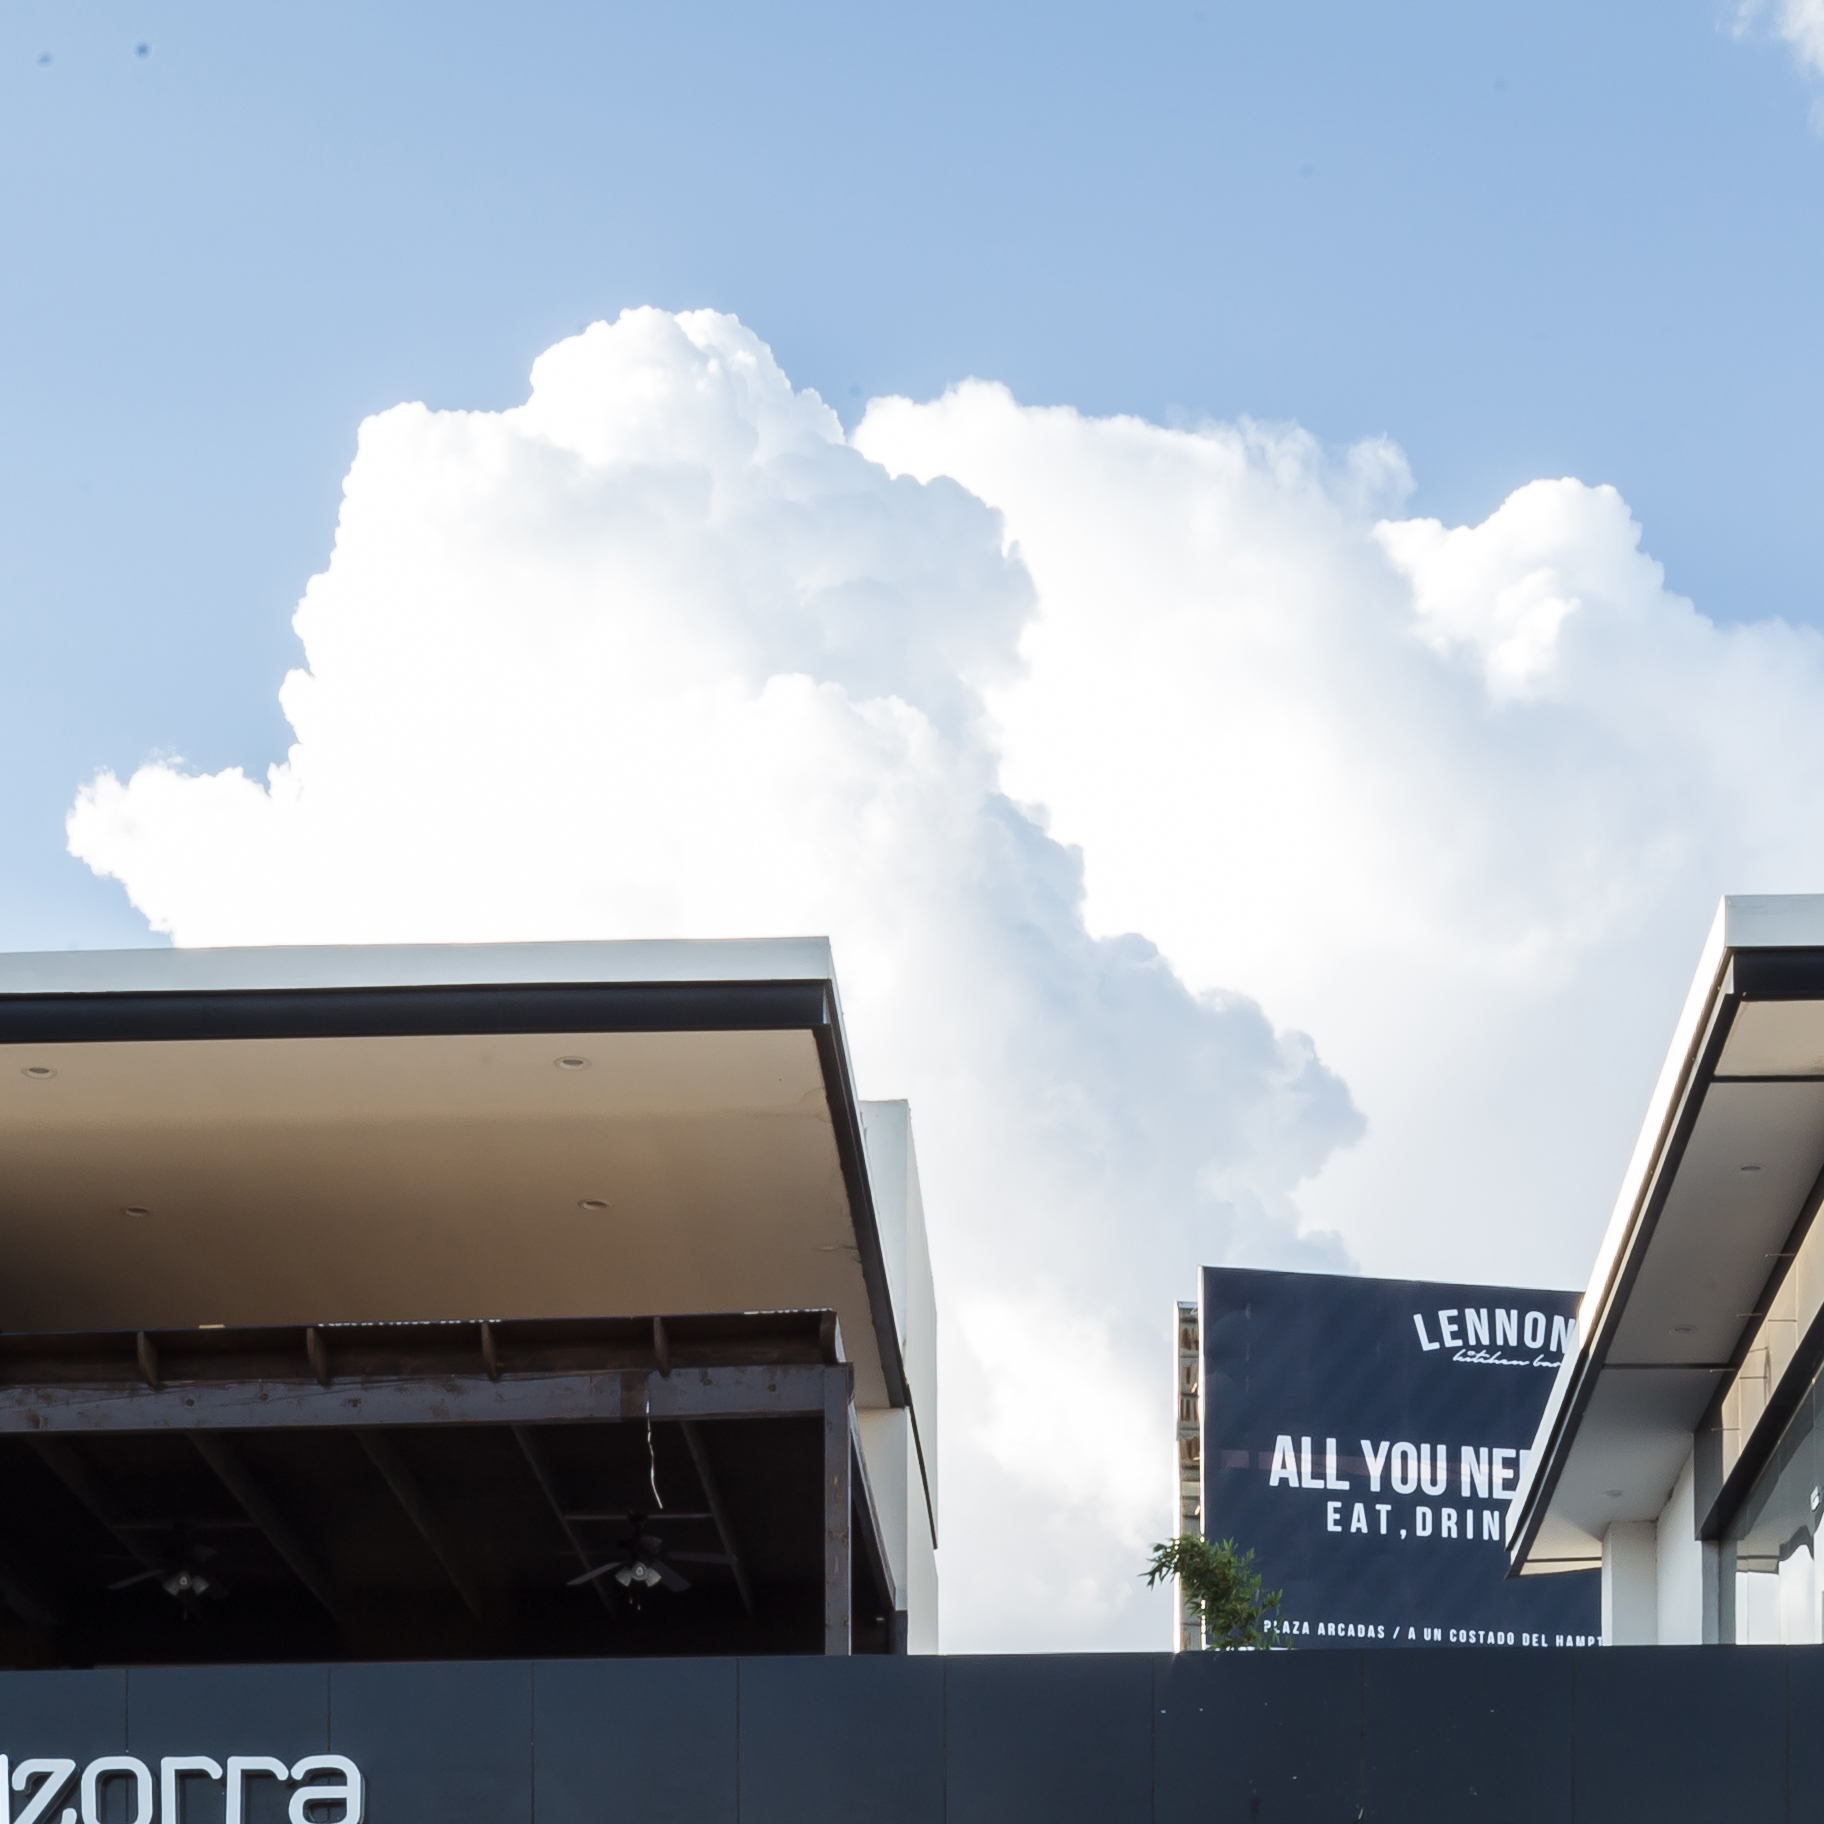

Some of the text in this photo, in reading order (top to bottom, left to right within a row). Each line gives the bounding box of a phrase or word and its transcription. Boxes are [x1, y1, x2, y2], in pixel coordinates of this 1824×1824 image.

[1413, 1308, 1576, 1353] LENNON
[1452, 1349, 1530, 1366] kitchen
[1269, 1435, 1350, 1490] ALL
[1360, 1440, 1447, 1496] YOU
[1317, 1622, 1385, 1639] ARCADAS
[1407, 1627, 1416, 1640] A
[1423, 1628, 1442, 1642] UN
[1449, 1629, 1515, 1646] COSTADO
[1522, 1633, 1549, 1647] DEL
